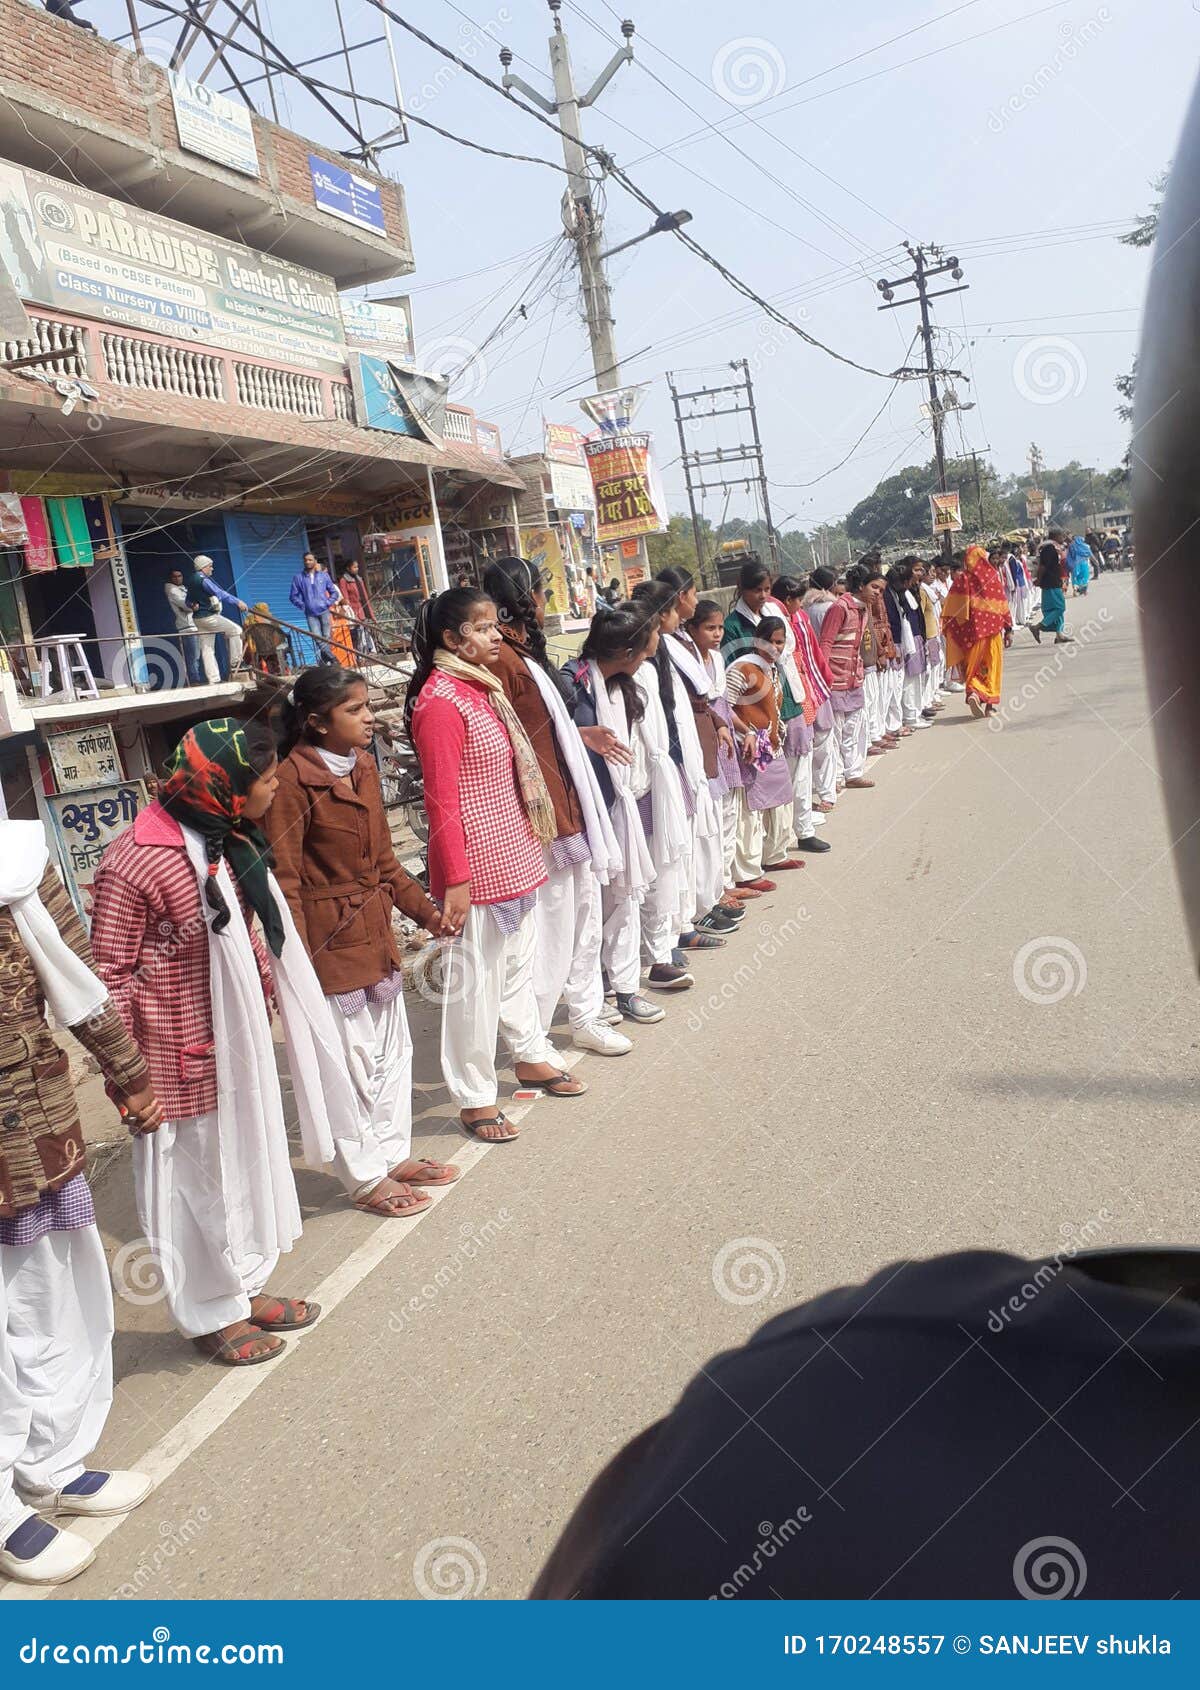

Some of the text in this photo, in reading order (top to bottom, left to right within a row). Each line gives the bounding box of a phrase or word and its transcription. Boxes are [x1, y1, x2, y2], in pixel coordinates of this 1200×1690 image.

[74, 203, 222, 289] PARADISE
[58, 247, 196, 299] (Based on CBSE Pattern)
[58, 271, 102, 297] Class:
[105, 285, 157, 315] Nursery
[160, 301, 173, 316] to
[226, 256, 340, 319] Central School
[62, 788, 139, 841] खुशी
[70, 842, 111, 872] डिजि
